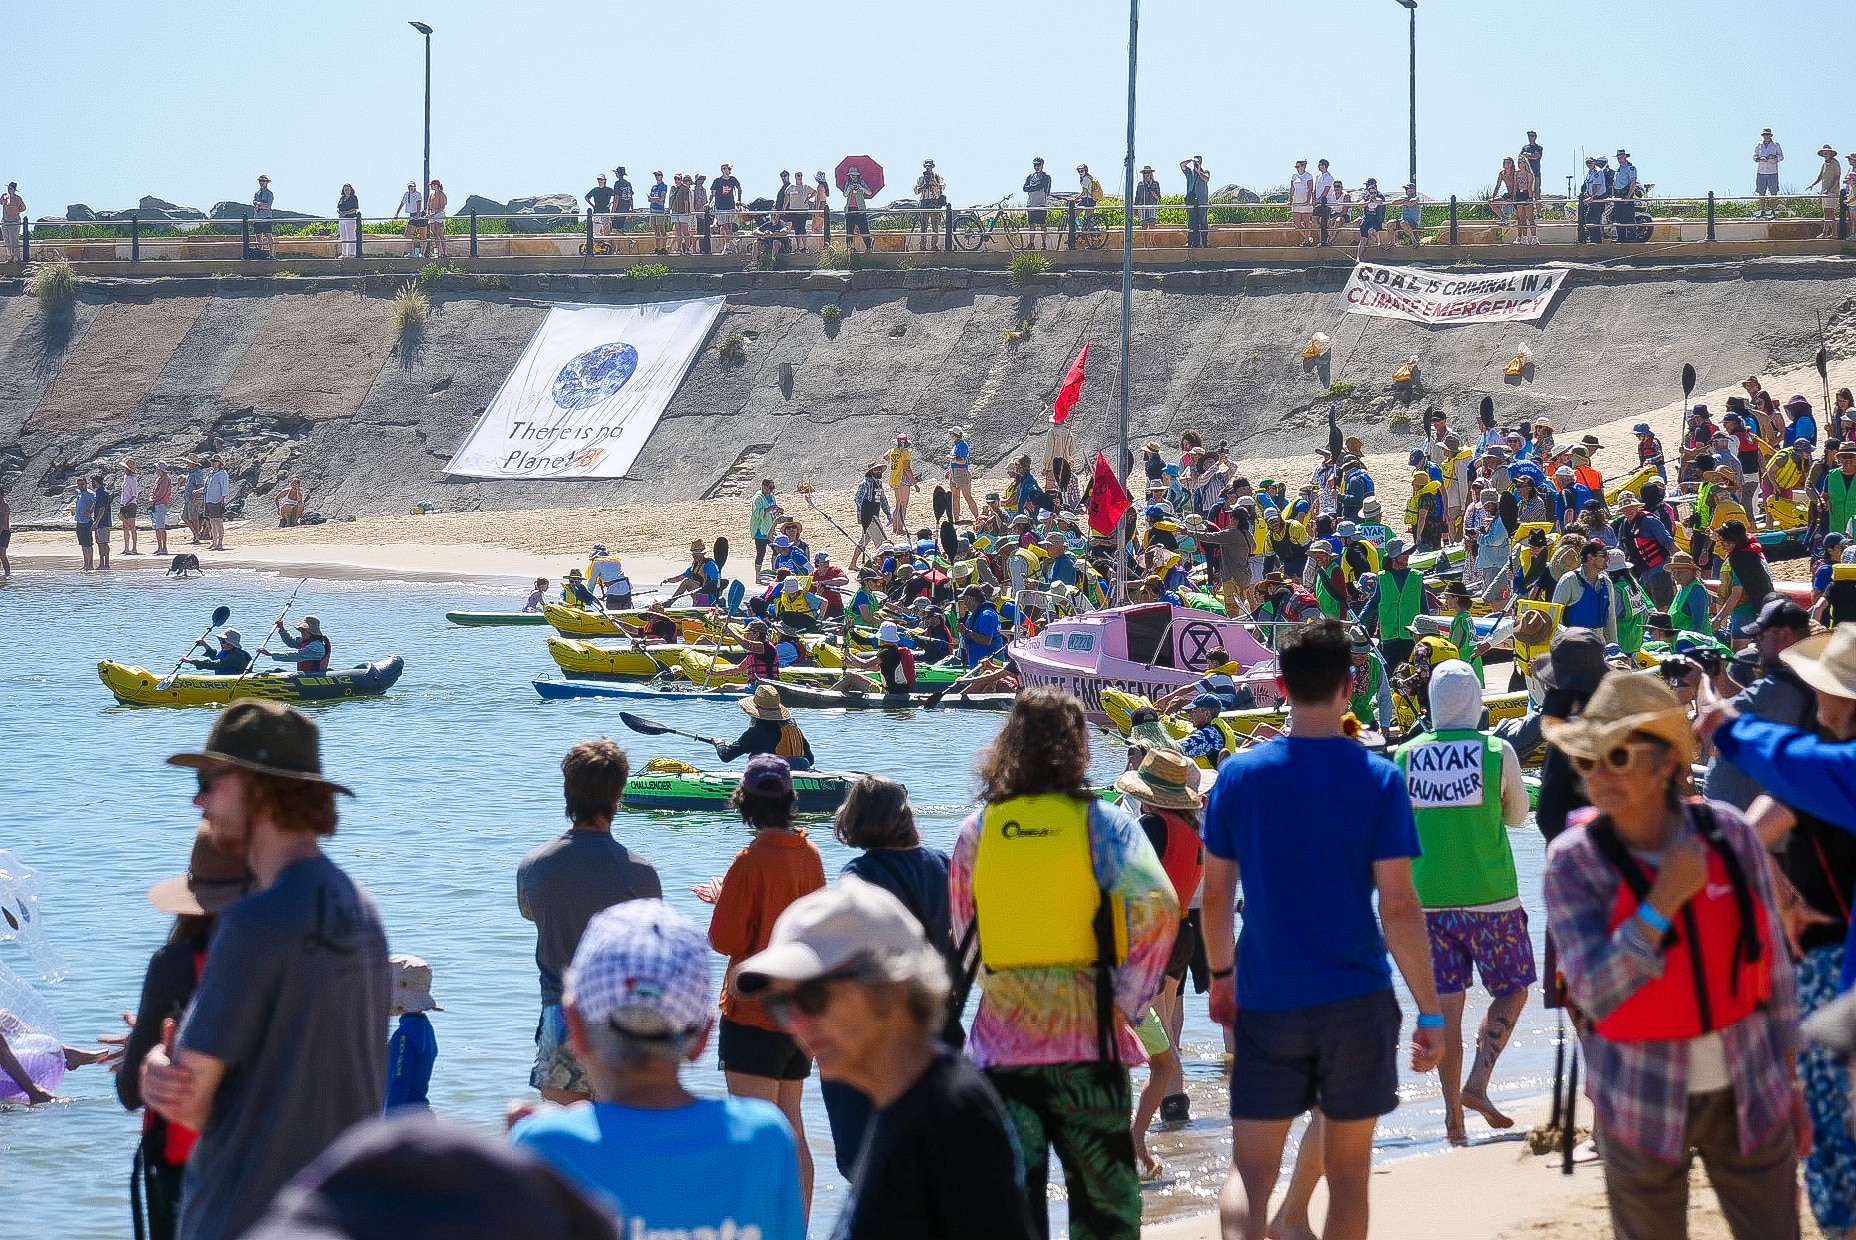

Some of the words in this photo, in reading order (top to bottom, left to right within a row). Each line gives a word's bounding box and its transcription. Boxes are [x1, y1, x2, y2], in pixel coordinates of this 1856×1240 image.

[1357, 265, 1422, 291] COAL
[1425, 280, 1442, 294] IS
[1443, 276, 1516, 296] CRIMINAL
[1521, 274, 1540, 292] IN
[1540, 275, 1553, 292] A
[1347, 287, 1422, 313] CLIMATE
[1422, 297, 1545, 317] EMERGENCY
[508, 421, 572, 440] There
[574, 425, 594, 440] is
[595, 426, 624, 439] no
[502, 450, 576, 469] Planet
[608, 649, 663, 657] EXPLOER
[170, 680, 231, 690] EXPLORER
[1484, 699, 1529, 712] PLORE
[1409, 744, 1481, 773] KAYAK
[630, 780, 673, 791] CHALLENGER
[1408, 772, 1483, 802] LAUNCHER
